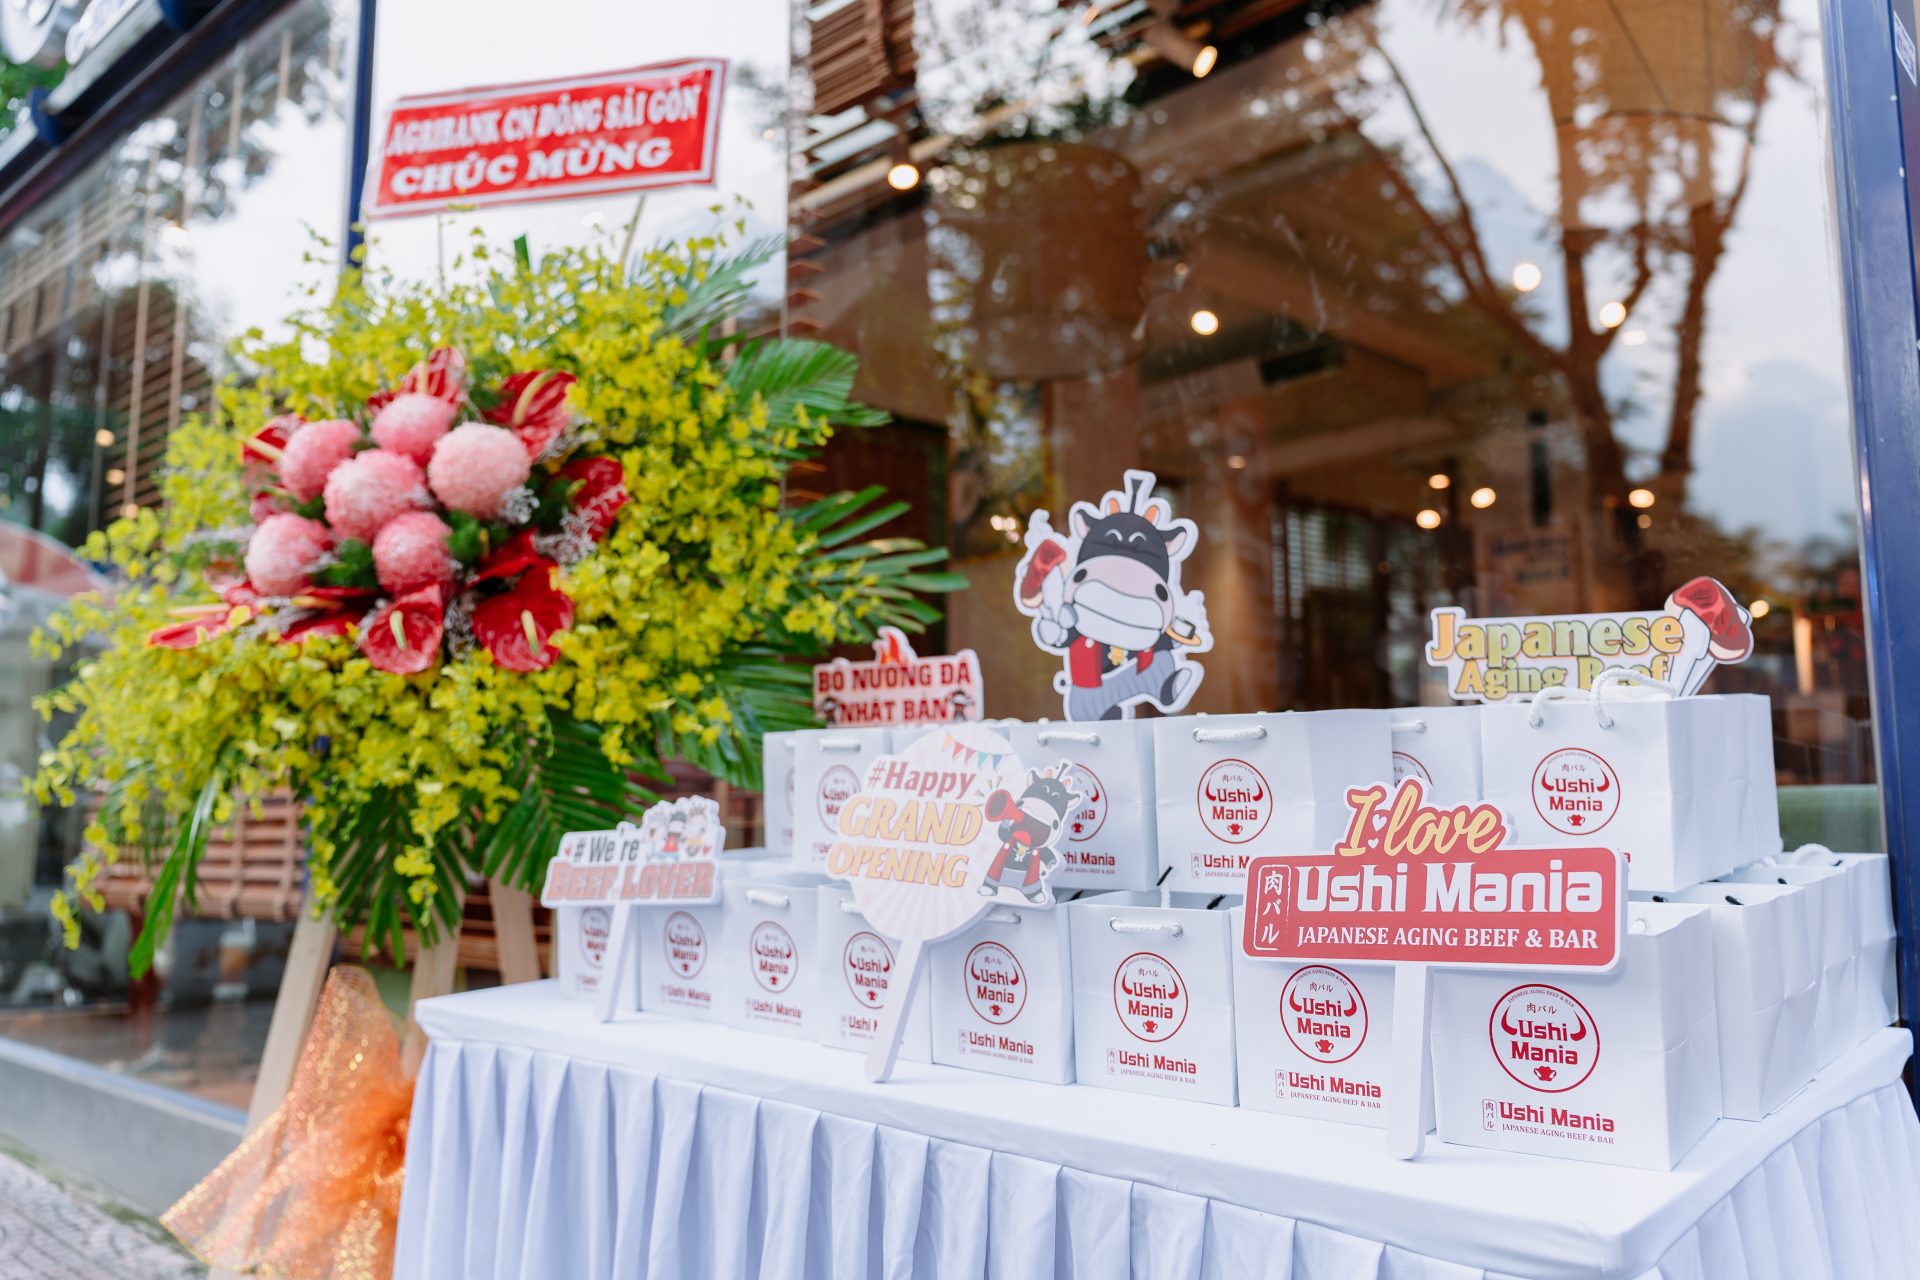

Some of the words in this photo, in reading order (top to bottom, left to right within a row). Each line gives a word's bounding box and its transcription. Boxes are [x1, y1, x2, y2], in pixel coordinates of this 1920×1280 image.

[1431, 612, 1686, 669] Japanese
[1454, 658, 1567, 699] Aging
[867, 760, 976, 800] #Happy
[1555, 778, 1595, 793] Ushi
[1216, 787, 1251, 802] Ushi
[1549, 796, 1603, 811] Mania
[839, 795, 984, 846] GRAND
[1212, 806, 1258, 820] Mania
[1339, 790, 1382, 857] I
[1382, 784, 1502, 857] love
[827, 842, 970, 888] OPENING
[1081, 852, 1115, 866] Mania
[1203, 854, 1234, 868] Ushi
[1296, 862, 1408, 912] Ushi
[1421, 859, 1603, 913] Mania
[1297, 926, 1389, 948] JAPANESE
[1393, 927, 1458, 946] AGING
[1464, 926, 1519, 948] BEEF
[1524, 928, 1543, 948] &
[1549, 927, 1599, 949] BAR
[980, 969, 1009, 985] Ushi
[977, 985, 1014, 1003] Mania
[1133, 982, 1167, 999] Ushi
[1128, 1000, 1173, 1019] Mania
[1302, 997, 1342, 1017] Ushi
[1526, 1003, 1557, 1015] 肉バル
[1297, 1017, 1351, 1038] Mania
[1518, 1019, 1568, 1042] Ushi
[969, 1031, 995, 1048] Ushi
[998, 1036, 1034, 1055] Mania
[1510, 1040, 1578, 1065] Mania
[1119, 1050, 1149, 1068] Ushi
[1153, 1055, 1197, 1075] Mania
[1288, 1072, 1325, 1092] Ushi
[1329, 1076, 1382, 1098] Mania
[1290, 1091, 1321, 1101] JAPANESE
[1321, 1095, 1342, 1104] AGING
[1367, 1101, 1381, 1109] BAR
[1499, 1101, 1544, 1123] Ushi
[1550, 1108, 1615, 1133] Mania
[1502, 1123, 1539, 1135] JAPANESE
[1540, 1128, 1565, 1139] AGING
[1567, 1132, 1587, 1141] BEEF
[1597, 1135, 1615, 1145] BAR
